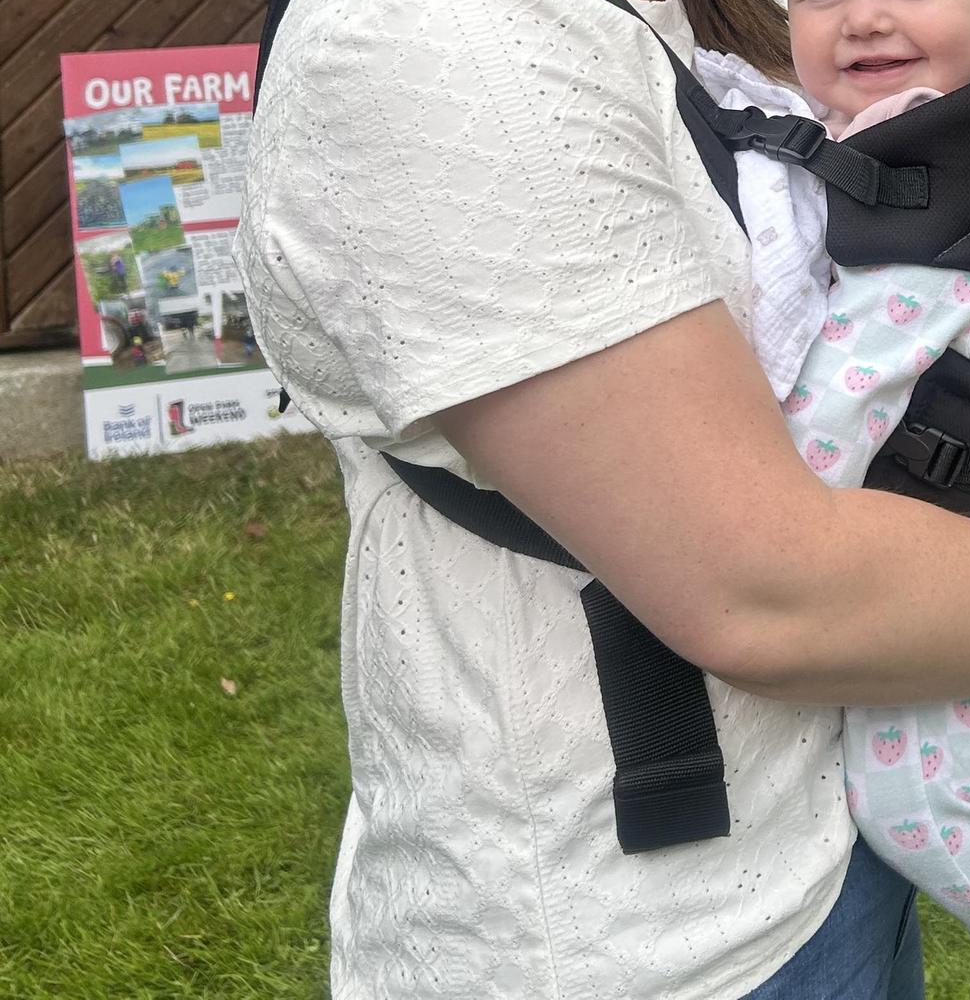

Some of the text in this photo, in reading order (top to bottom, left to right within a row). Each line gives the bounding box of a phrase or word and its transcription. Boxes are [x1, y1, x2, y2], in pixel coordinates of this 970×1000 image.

[84, 71, 250, 110] OUR FARM
[189, 409, 247, 426] WEEKEND
